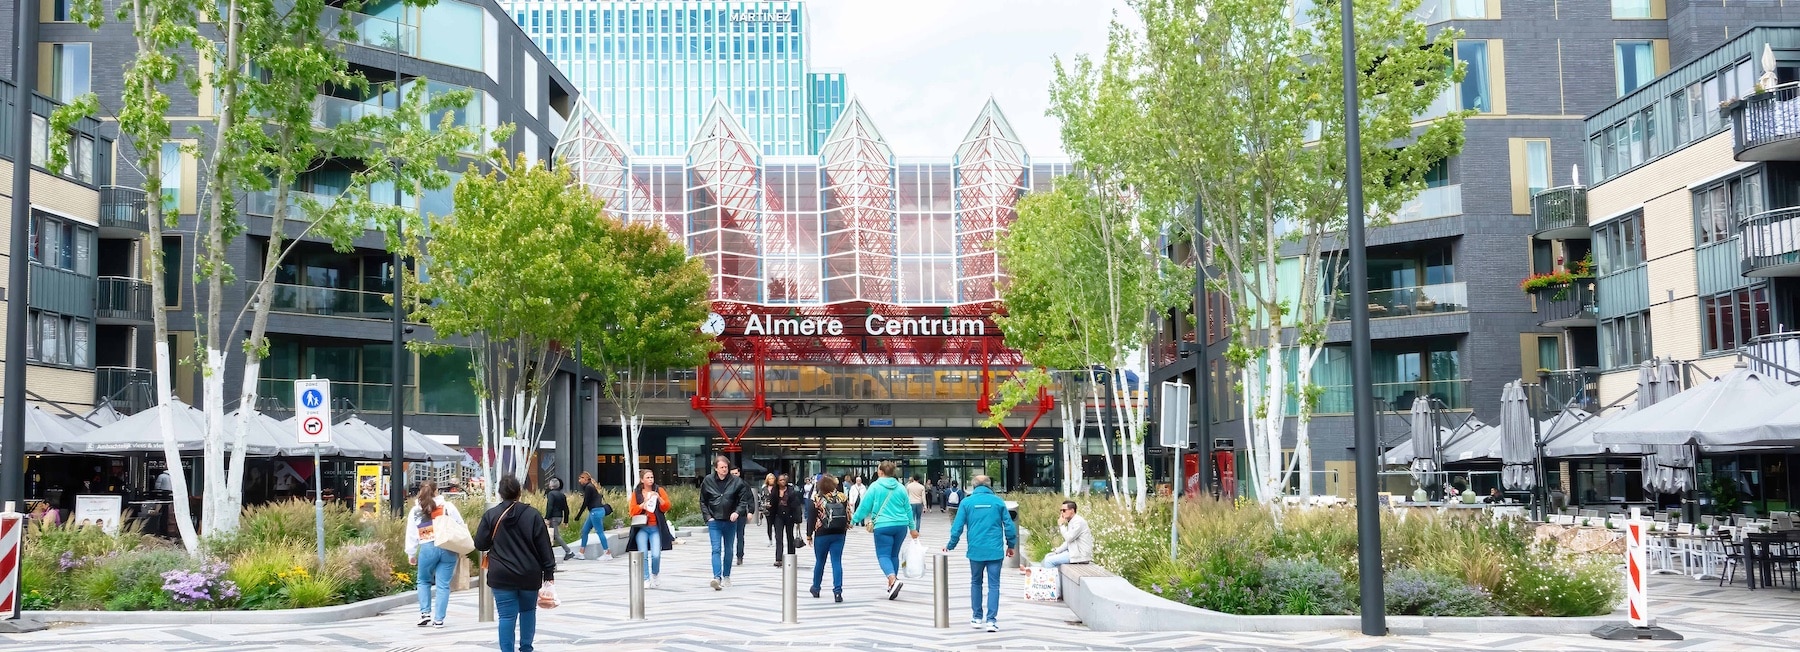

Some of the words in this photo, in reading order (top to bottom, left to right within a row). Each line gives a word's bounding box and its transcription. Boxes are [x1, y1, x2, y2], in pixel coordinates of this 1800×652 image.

[730, 13, 791, 22] MARTINEZ
[744, 314, 843, 336] Almere
[865, 314, 984, 336] Centrum
